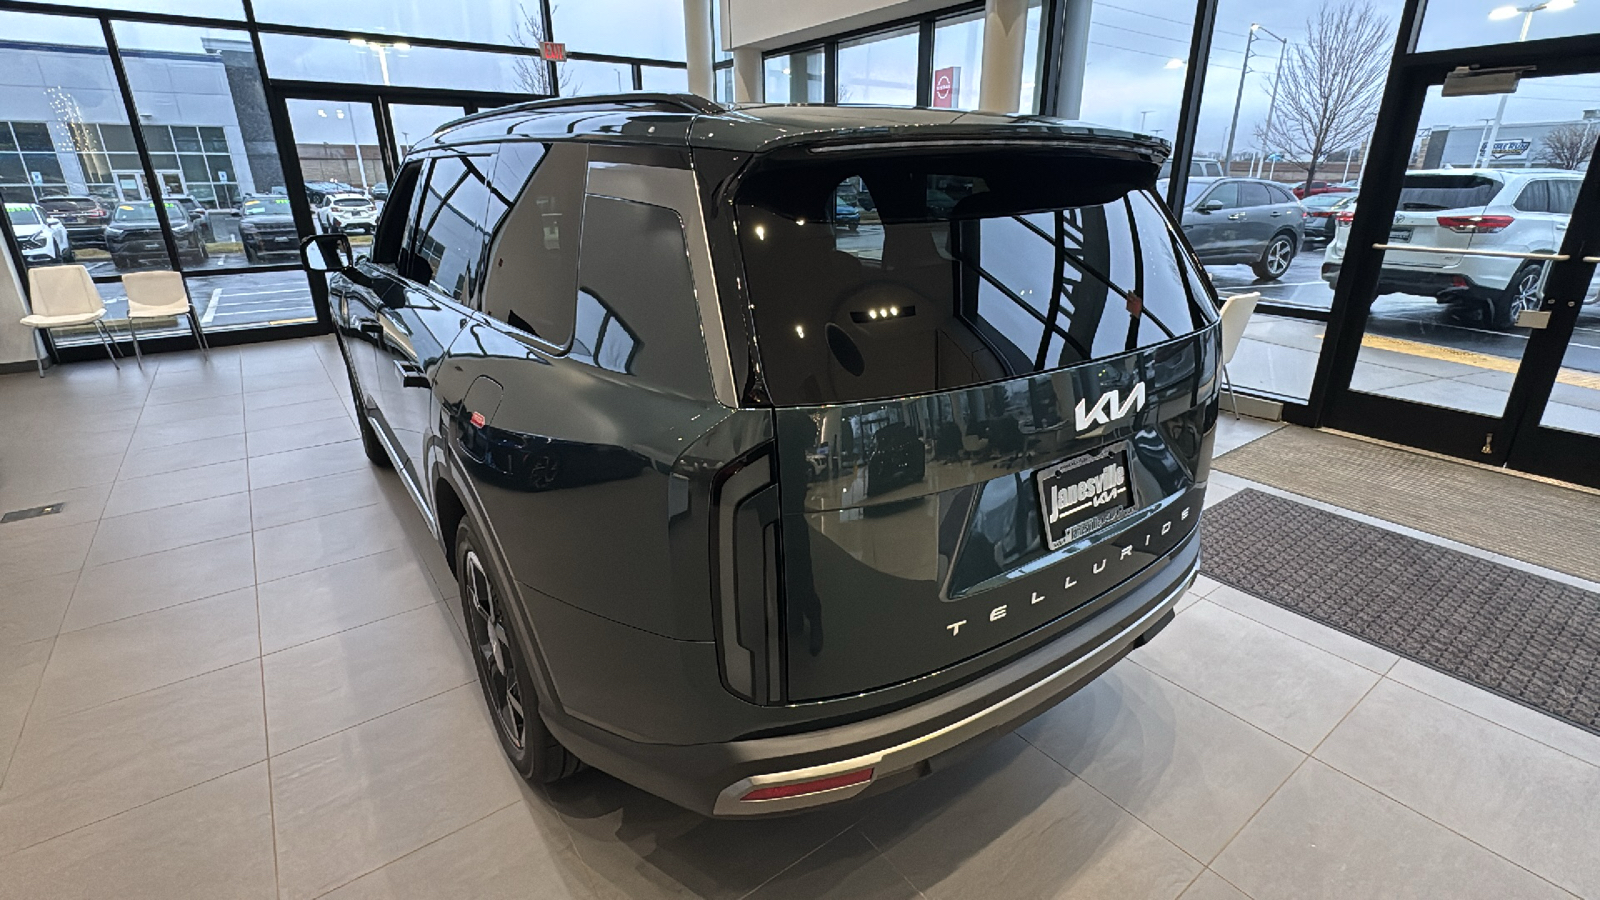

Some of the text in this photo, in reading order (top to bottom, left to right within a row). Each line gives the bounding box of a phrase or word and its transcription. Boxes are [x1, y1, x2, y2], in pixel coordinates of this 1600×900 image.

[544, 43, 563, 60] EXIT
[1049, 462, 1125, 523] Janesville
[946, 507, 1190, 637] TELLURIDE
